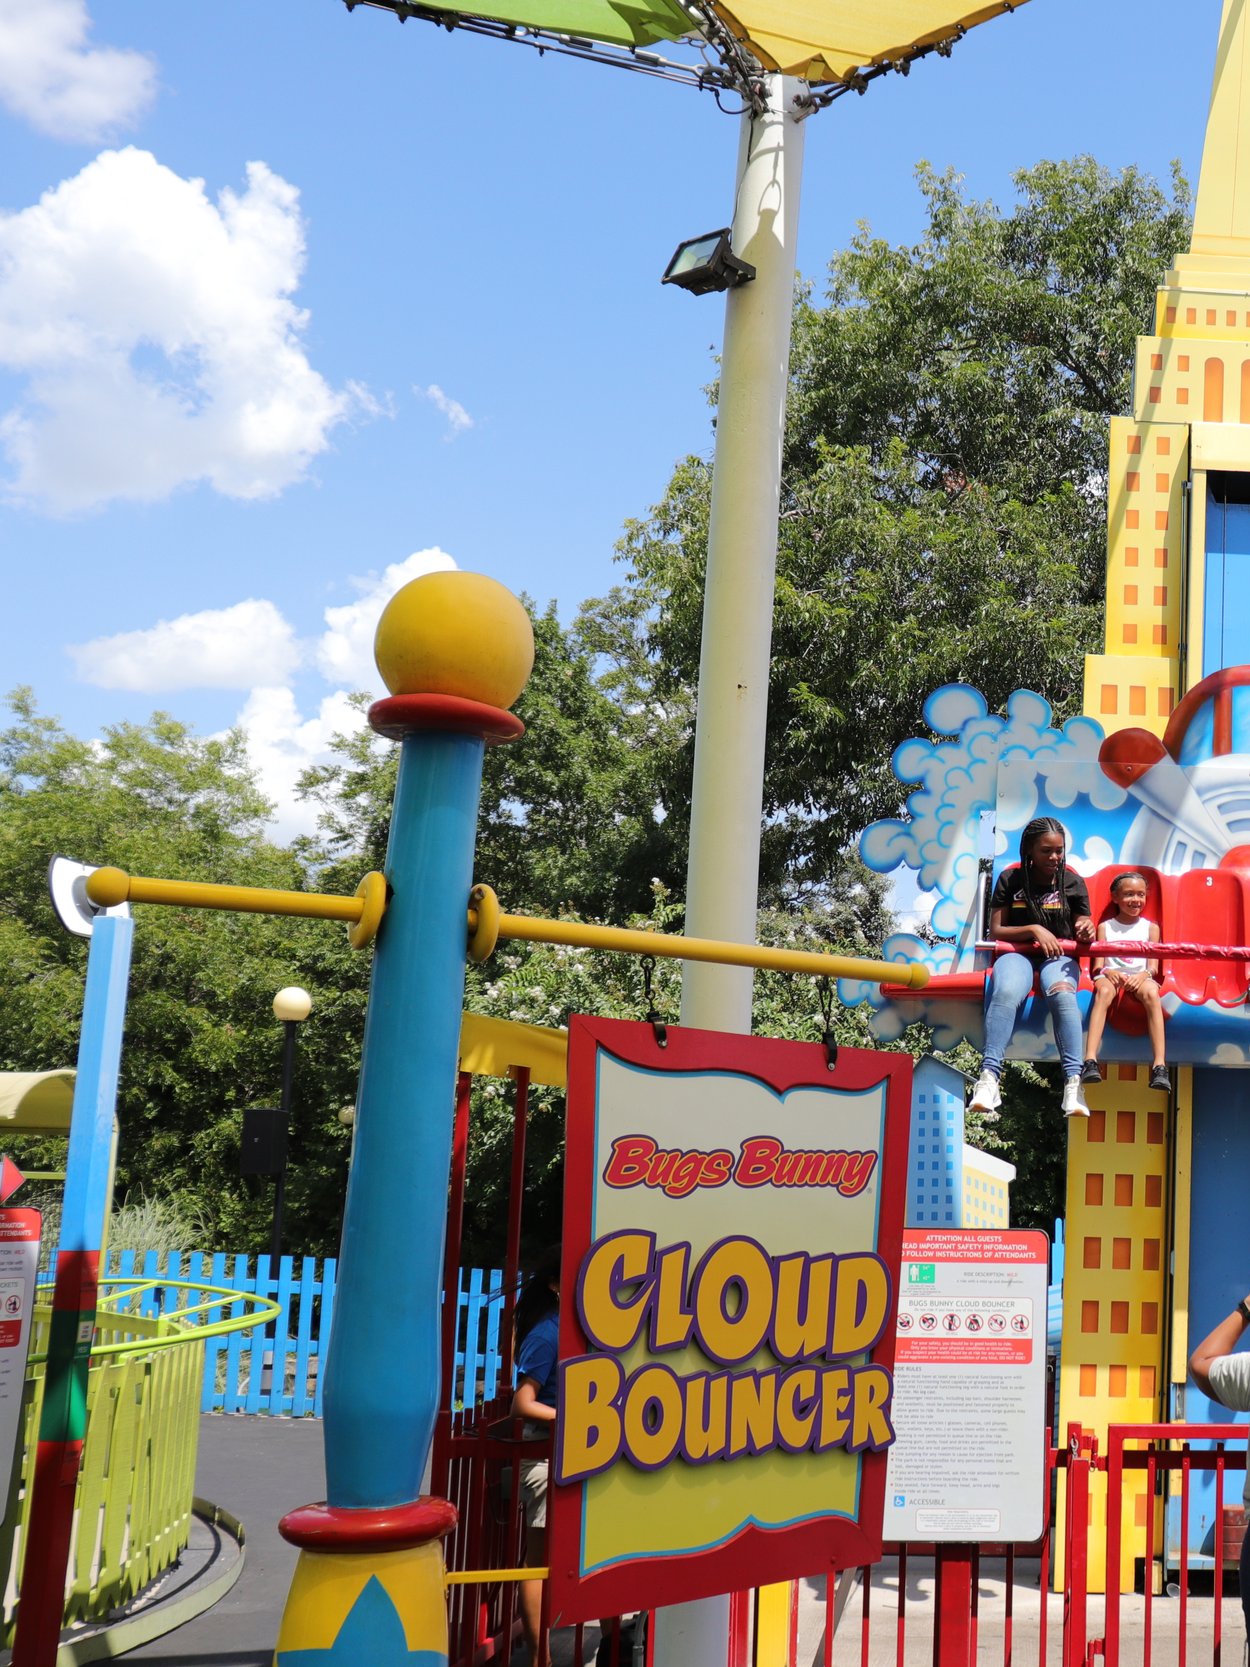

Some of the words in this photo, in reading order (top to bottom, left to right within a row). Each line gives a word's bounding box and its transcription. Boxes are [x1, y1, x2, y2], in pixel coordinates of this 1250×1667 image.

[1206, 876, 1213, 886] 3
[602, 1134, 736, 1200] Bugs
[732, 1135, 879, 1198] Bunny
[577, 1228, 893, 1367] CLOUD
[956, 1300, 980, 1308] CLOUD
[554, 1352, 896, 1486] BOUNCER
[909, 1498, 945, 1506] ACCESSIBLE
